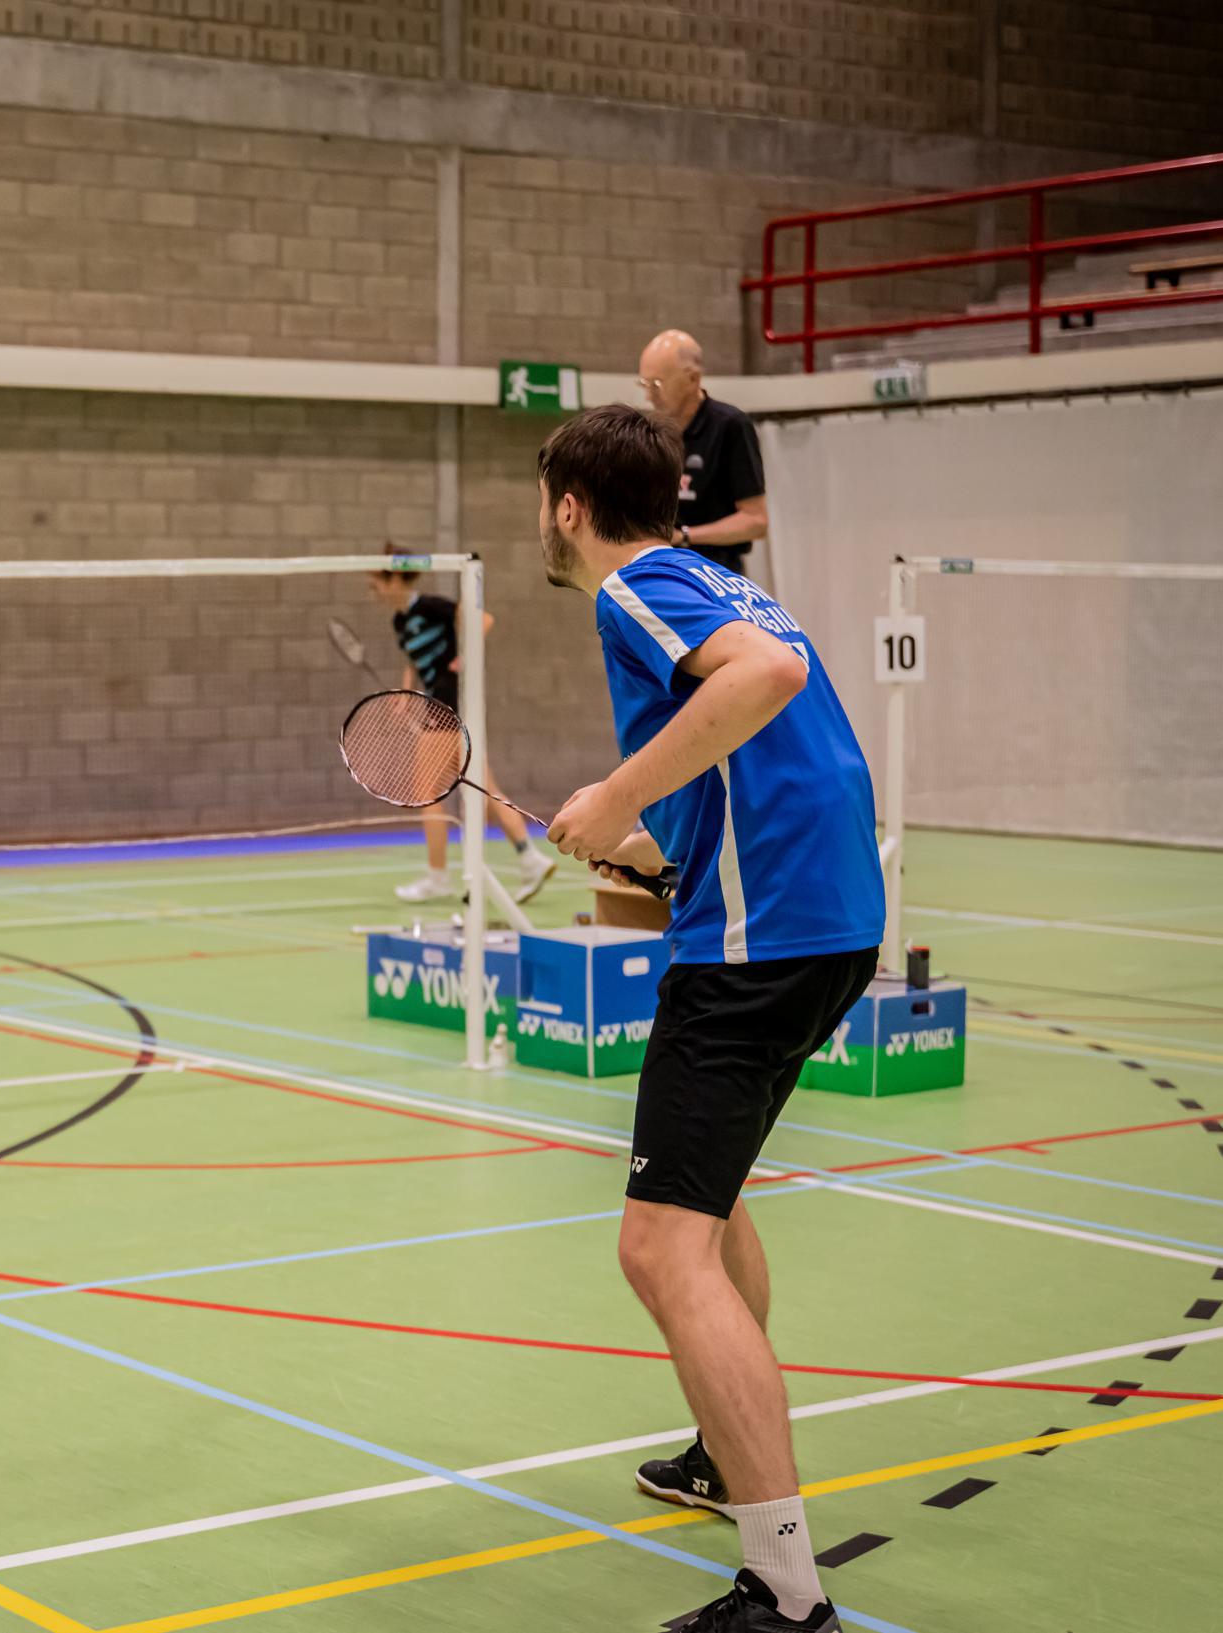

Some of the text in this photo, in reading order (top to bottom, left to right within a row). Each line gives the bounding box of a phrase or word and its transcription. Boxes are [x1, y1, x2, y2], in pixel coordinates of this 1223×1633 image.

[883, 634, 916, 671] 10
[417, 964, 502, 1015] YONX
[542, 1017, 585, 1046] YONEX
[912, 1027, 955, 1053] YONEX
